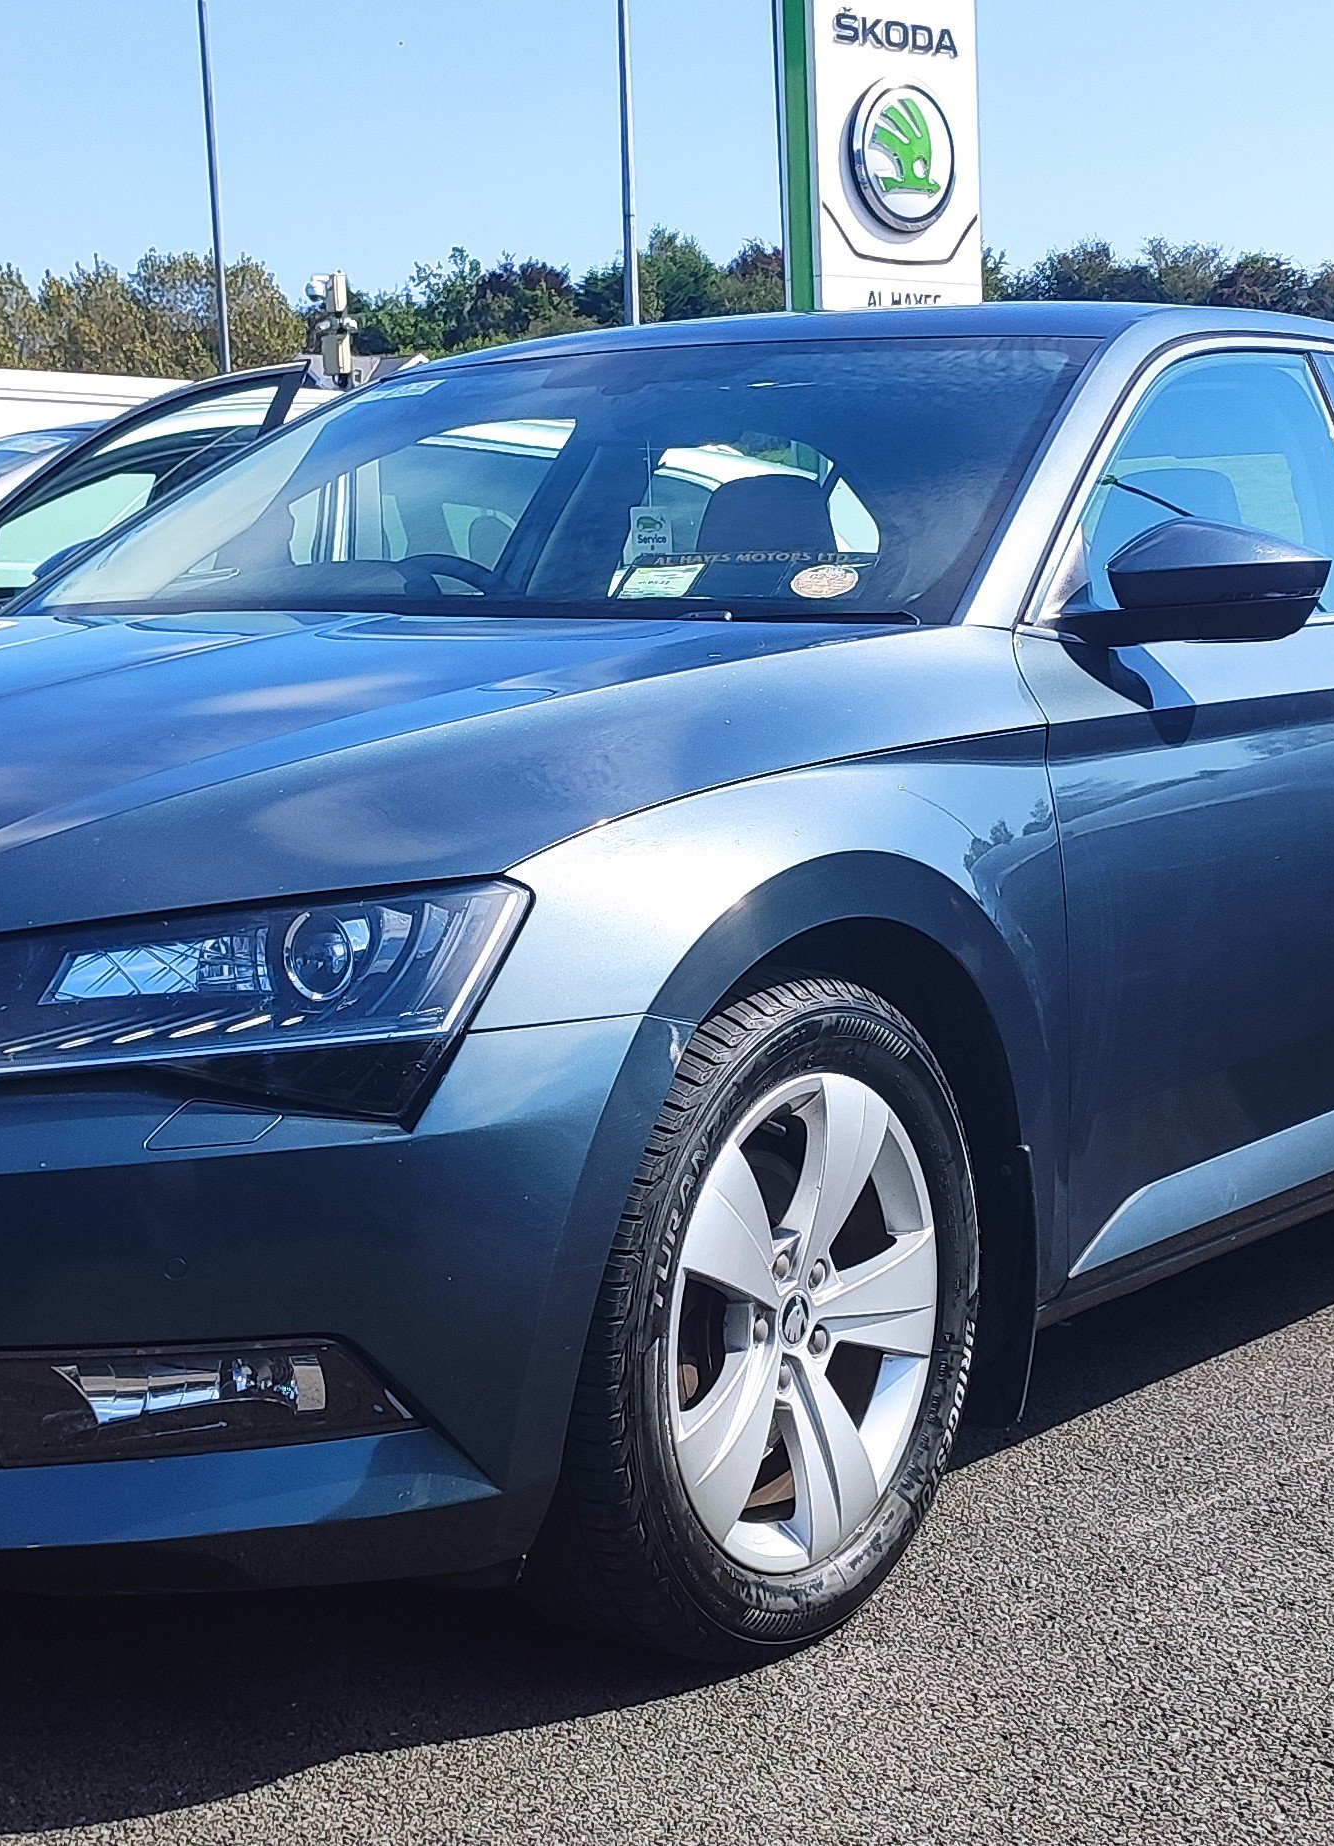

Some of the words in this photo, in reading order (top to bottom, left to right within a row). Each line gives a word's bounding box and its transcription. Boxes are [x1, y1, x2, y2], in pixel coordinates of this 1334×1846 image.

[832, 6, 958, 59] ŠKODA
[637, 533, 667, 544] Service
[653, 556, 676, 566] AL
[679, 552, 730, 565] HAYES
[735, 550, 812, 563] MOTORS
[649, 1081, 744, 1316] TURANZA
